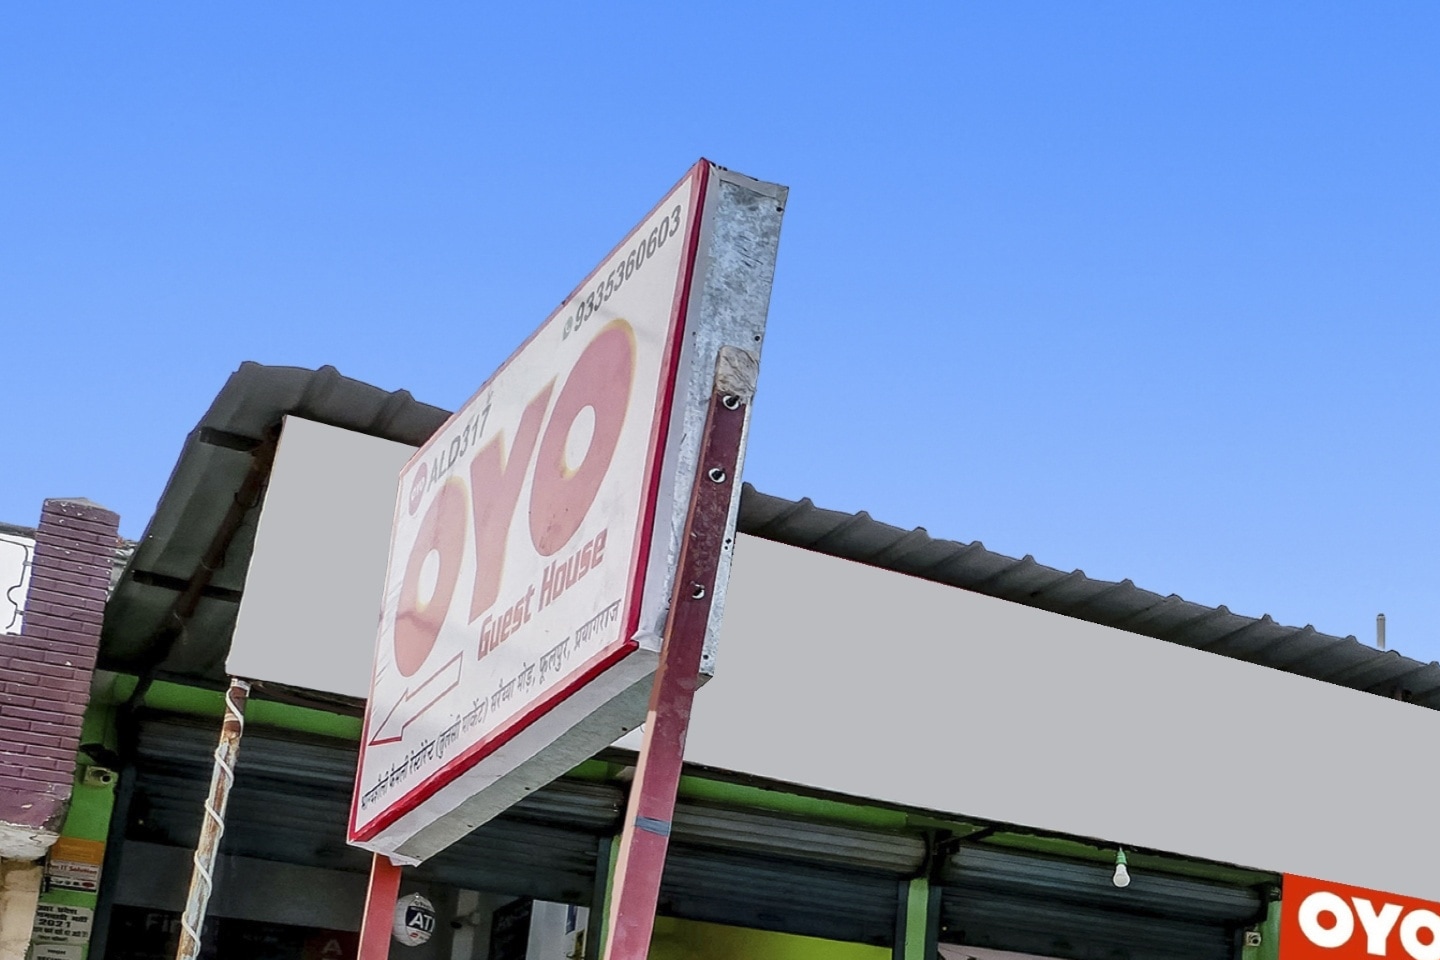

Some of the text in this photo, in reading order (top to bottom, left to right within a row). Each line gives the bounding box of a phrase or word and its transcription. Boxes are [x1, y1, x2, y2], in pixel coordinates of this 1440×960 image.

[573, 204, 681, 332] 9335360603
[394, 317, 637, 678] OYO
[426, 403, 492, 493] ALD317
[478, 528, 608, 662] Guest House
[38, 918, 71, 928] 2021
